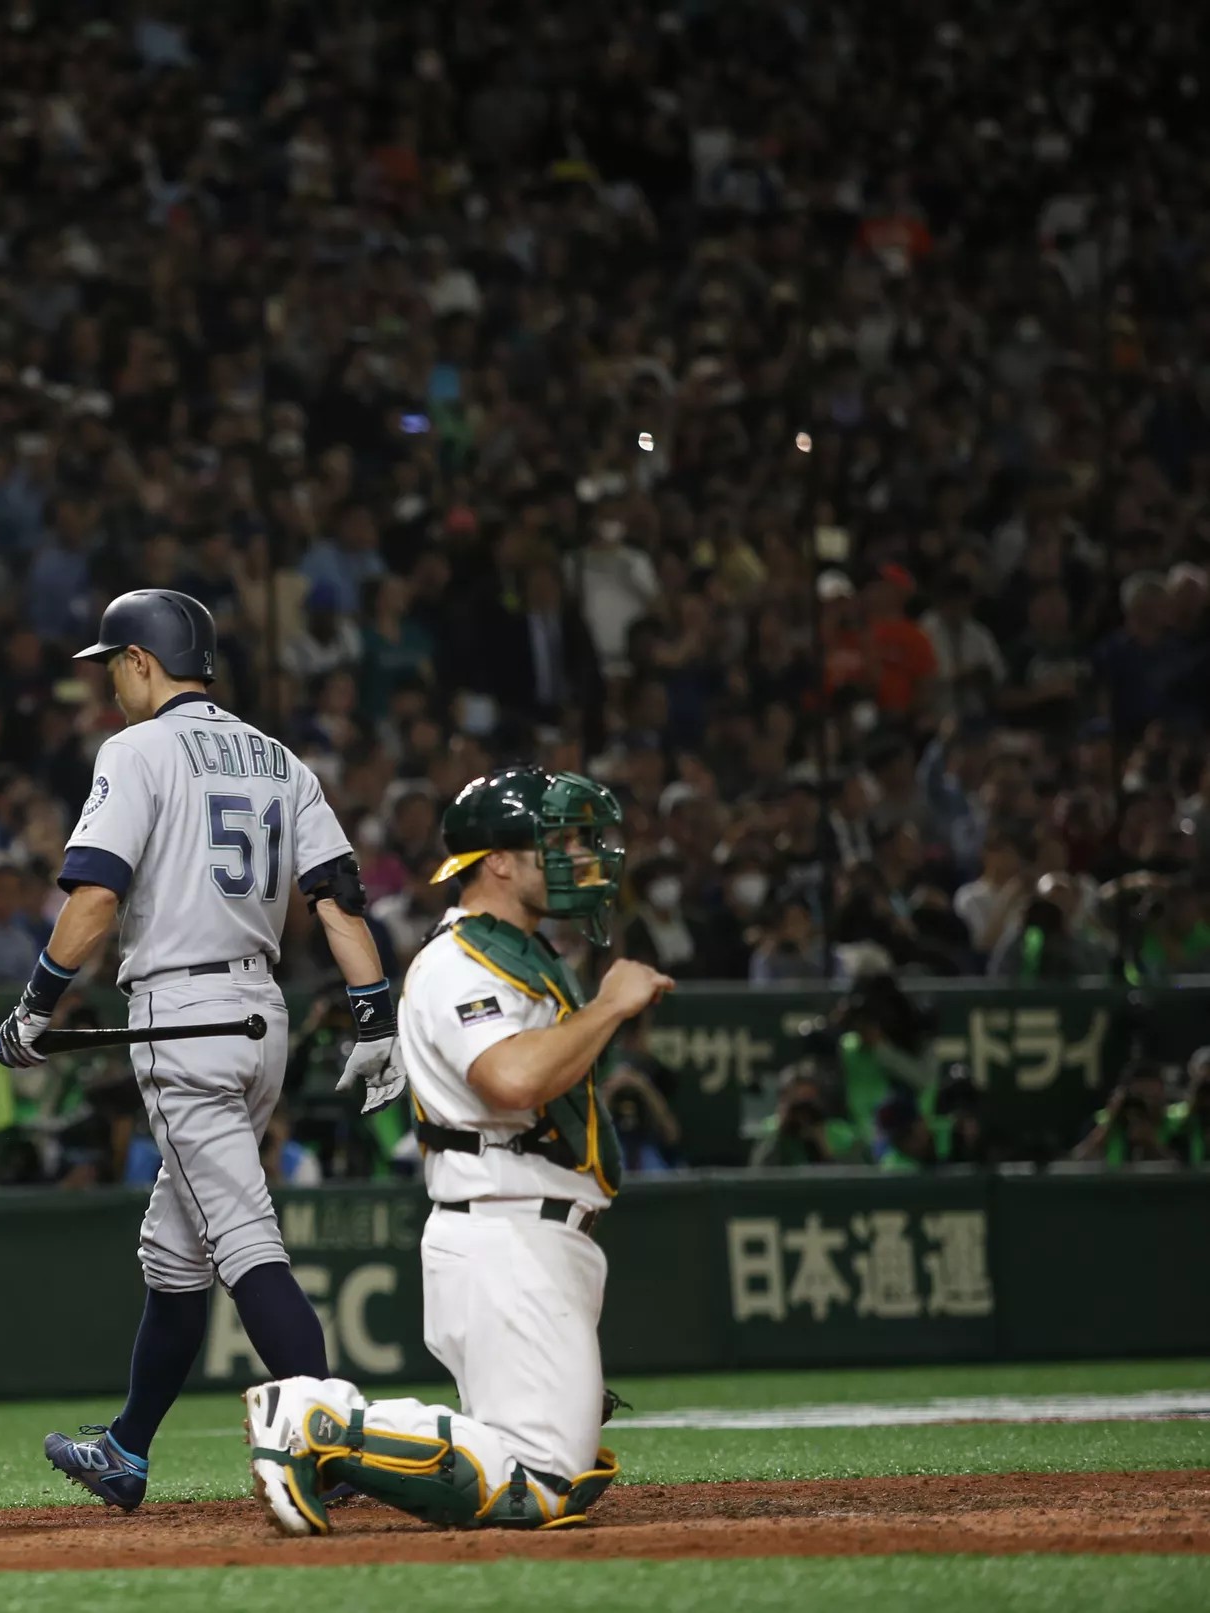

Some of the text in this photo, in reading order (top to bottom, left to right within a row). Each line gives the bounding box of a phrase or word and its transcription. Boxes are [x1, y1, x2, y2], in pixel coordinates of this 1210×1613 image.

[176, 728, 290, 784] ICHIRO
[204, 791, 283, 902] 51
[726, 1209, 994, 1322] 日本通運
